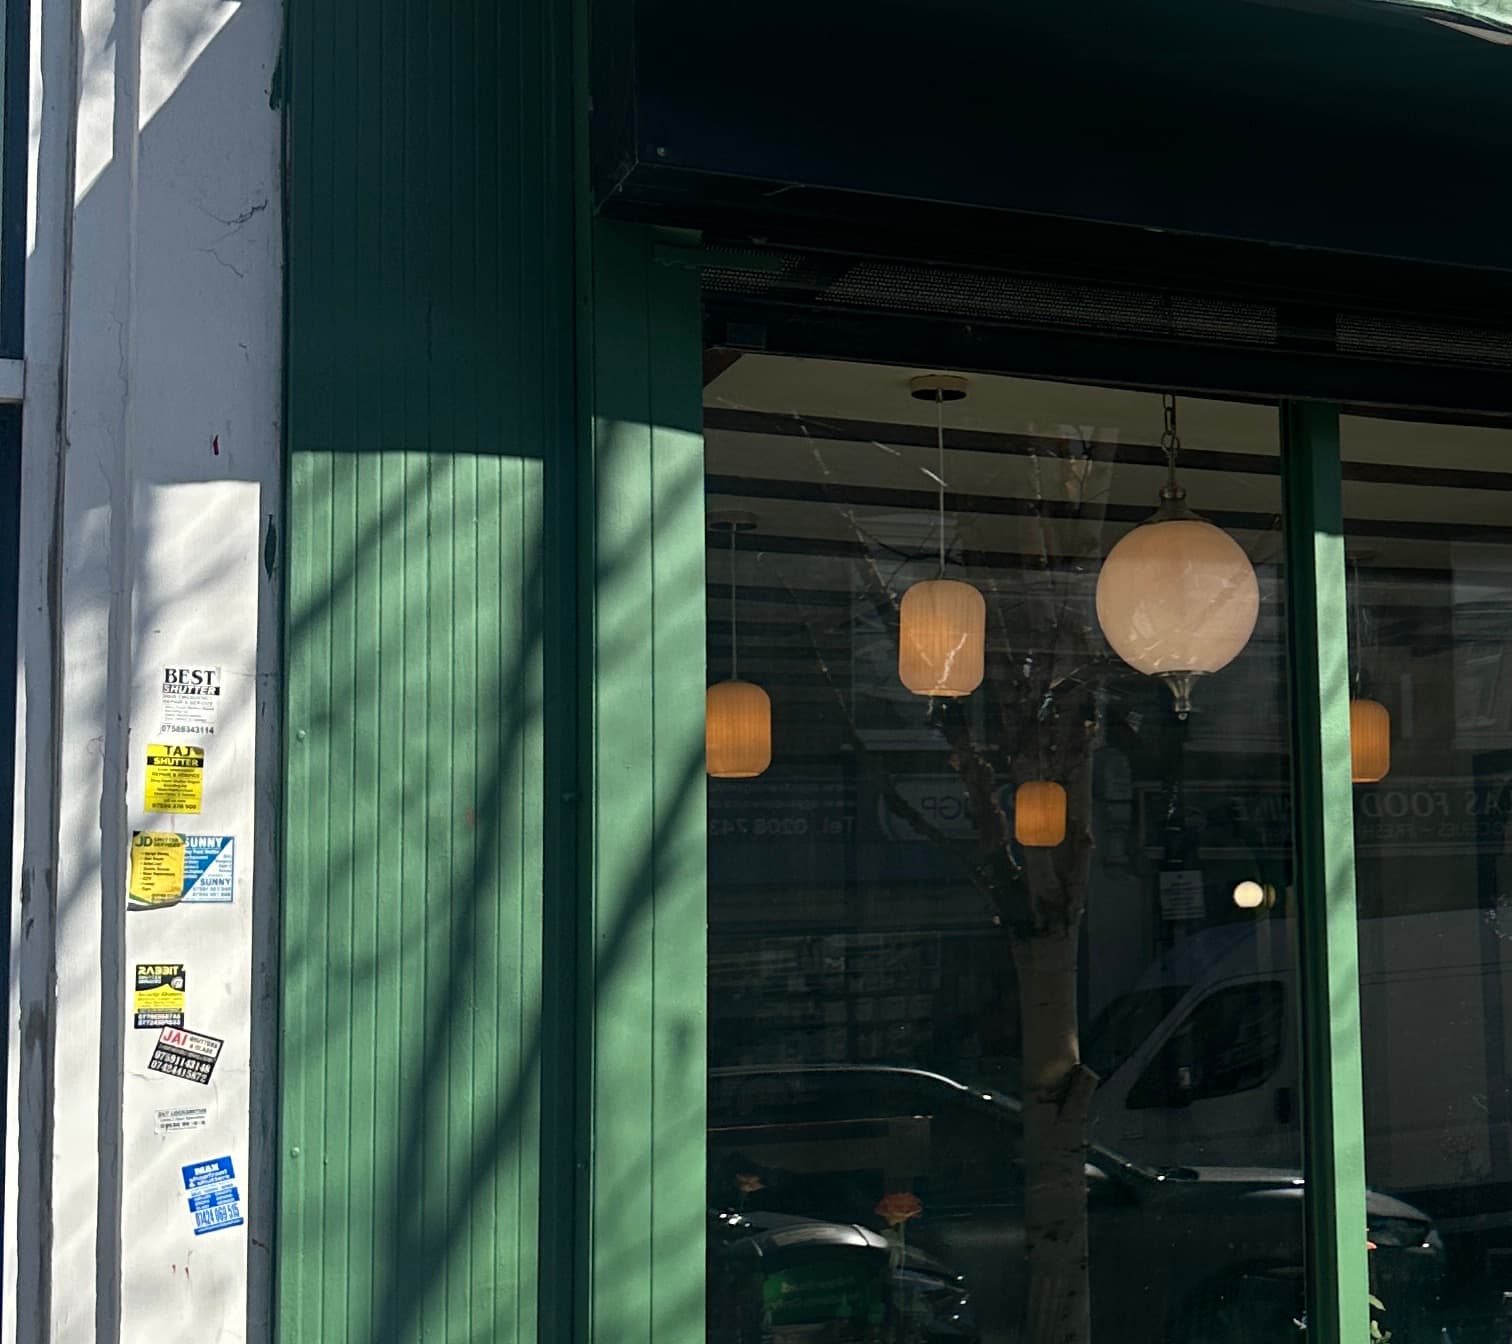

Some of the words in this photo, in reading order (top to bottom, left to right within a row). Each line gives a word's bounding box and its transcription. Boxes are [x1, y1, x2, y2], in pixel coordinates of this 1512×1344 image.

[165, 668, 216, 685] BEST
[163, 684, 216, 695] SHUTTER
[164, 744, 191, 756] TAJ
[154, 756, 198, 767] SHUTTER
[135, 836, 153, 847] JD
[184, 837, 222, 847] SUNNY
[200, 878, 231, 886] SUNNY
[138, 965, 179, 975] RABBIT
[163, 1030, 189, 1046] JAI
